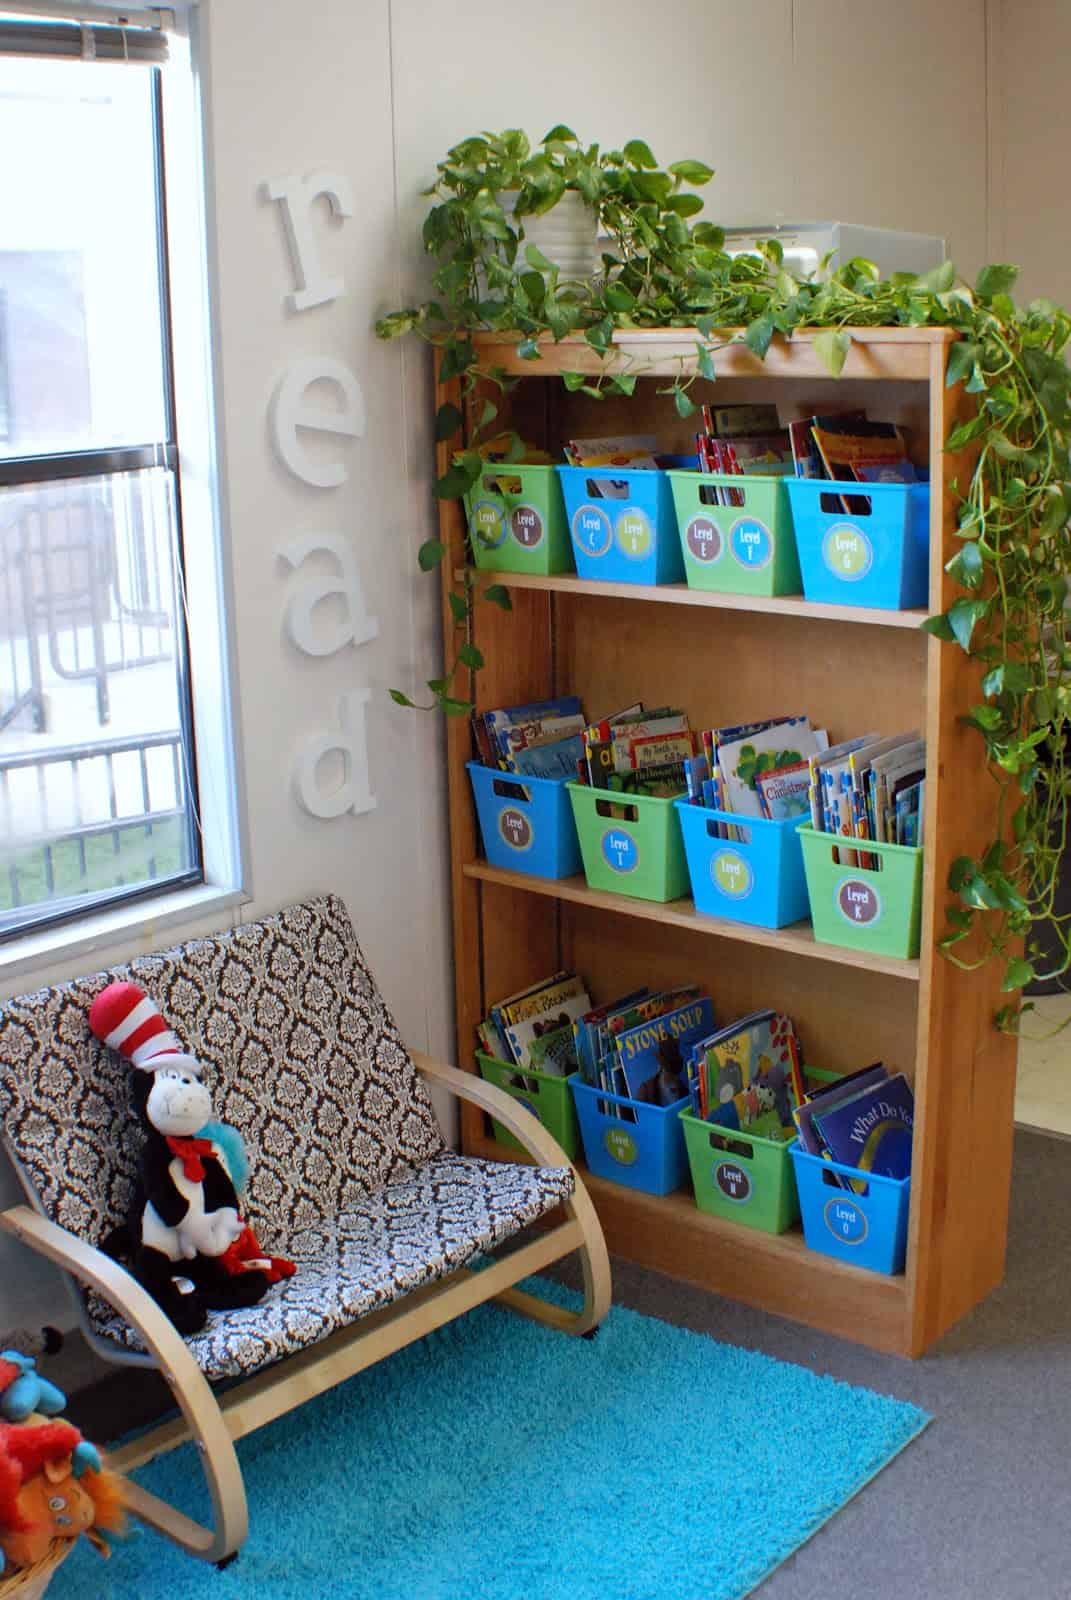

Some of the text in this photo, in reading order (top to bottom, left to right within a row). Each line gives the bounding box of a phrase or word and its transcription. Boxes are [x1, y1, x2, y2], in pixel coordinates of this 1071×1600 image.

[264, 174, 379, 819] read
[693, 523, 713, 542] Level
[740, 527, 761, 545] Level
[609, 833, 629, 852] Level
[847, 885, 869, 904] Level
[624, 1022, 668, 1059] STONE
[670, 1007, 703, 1039] SOUP
[849, 1102, 912, 1144] What Do Yo
[836, 1204, 856, 1224] Level
